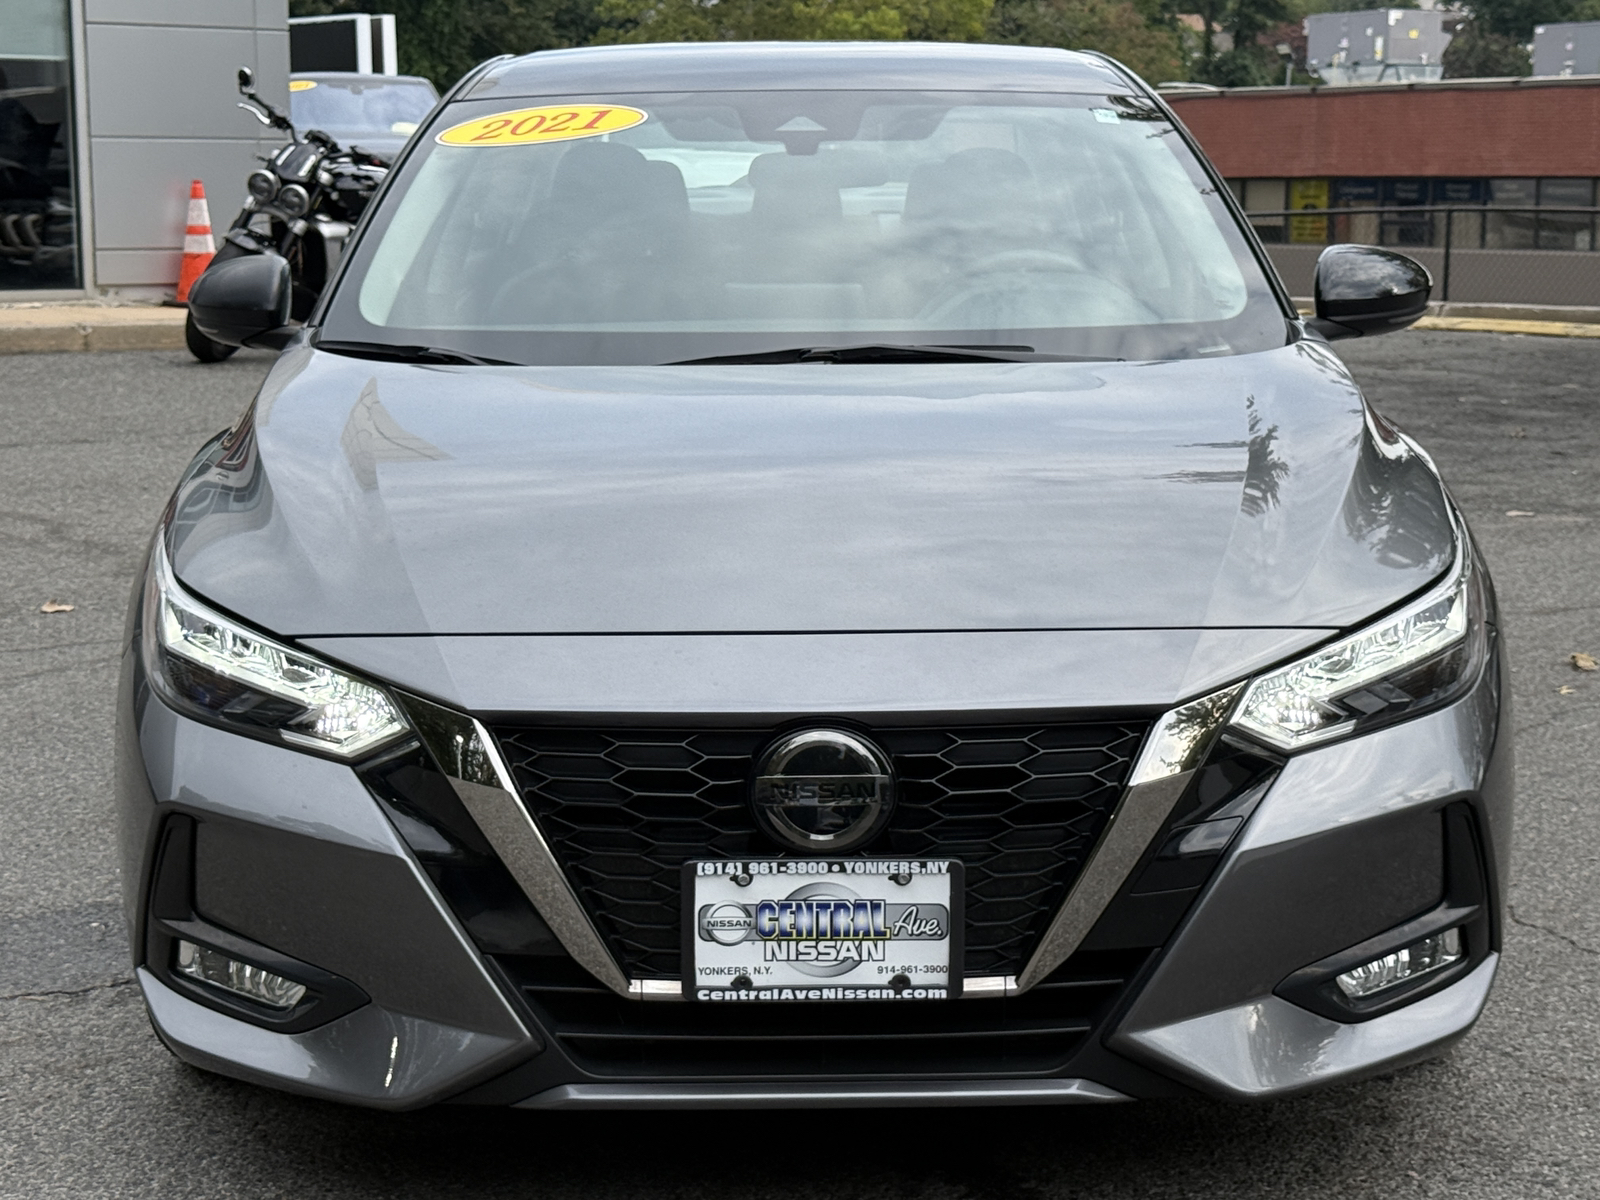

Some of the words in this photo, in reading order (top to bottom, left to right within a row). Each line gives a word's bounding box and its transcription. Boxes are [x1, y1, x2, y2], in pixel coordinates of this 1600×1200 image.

[470, 109, 613, 141] 2021
[770, 781, 876, 798] NISSAN
[748, 862, 829, 875] 961-3900
[706, 919, 752, 928] NISSAN
[755, 899, 892, 940] CENTRAL
[893, 904, 944, 937] Ave.
[764, 940, 885, 962] NISSAN
[698, 966, 751, 977] YONKERS,
[753, 966, 774, 975] N.Y.
[877, 964, 948, 975] 914-961-3900
[696, 987, 948, 1001] CentralAveNissan.com
